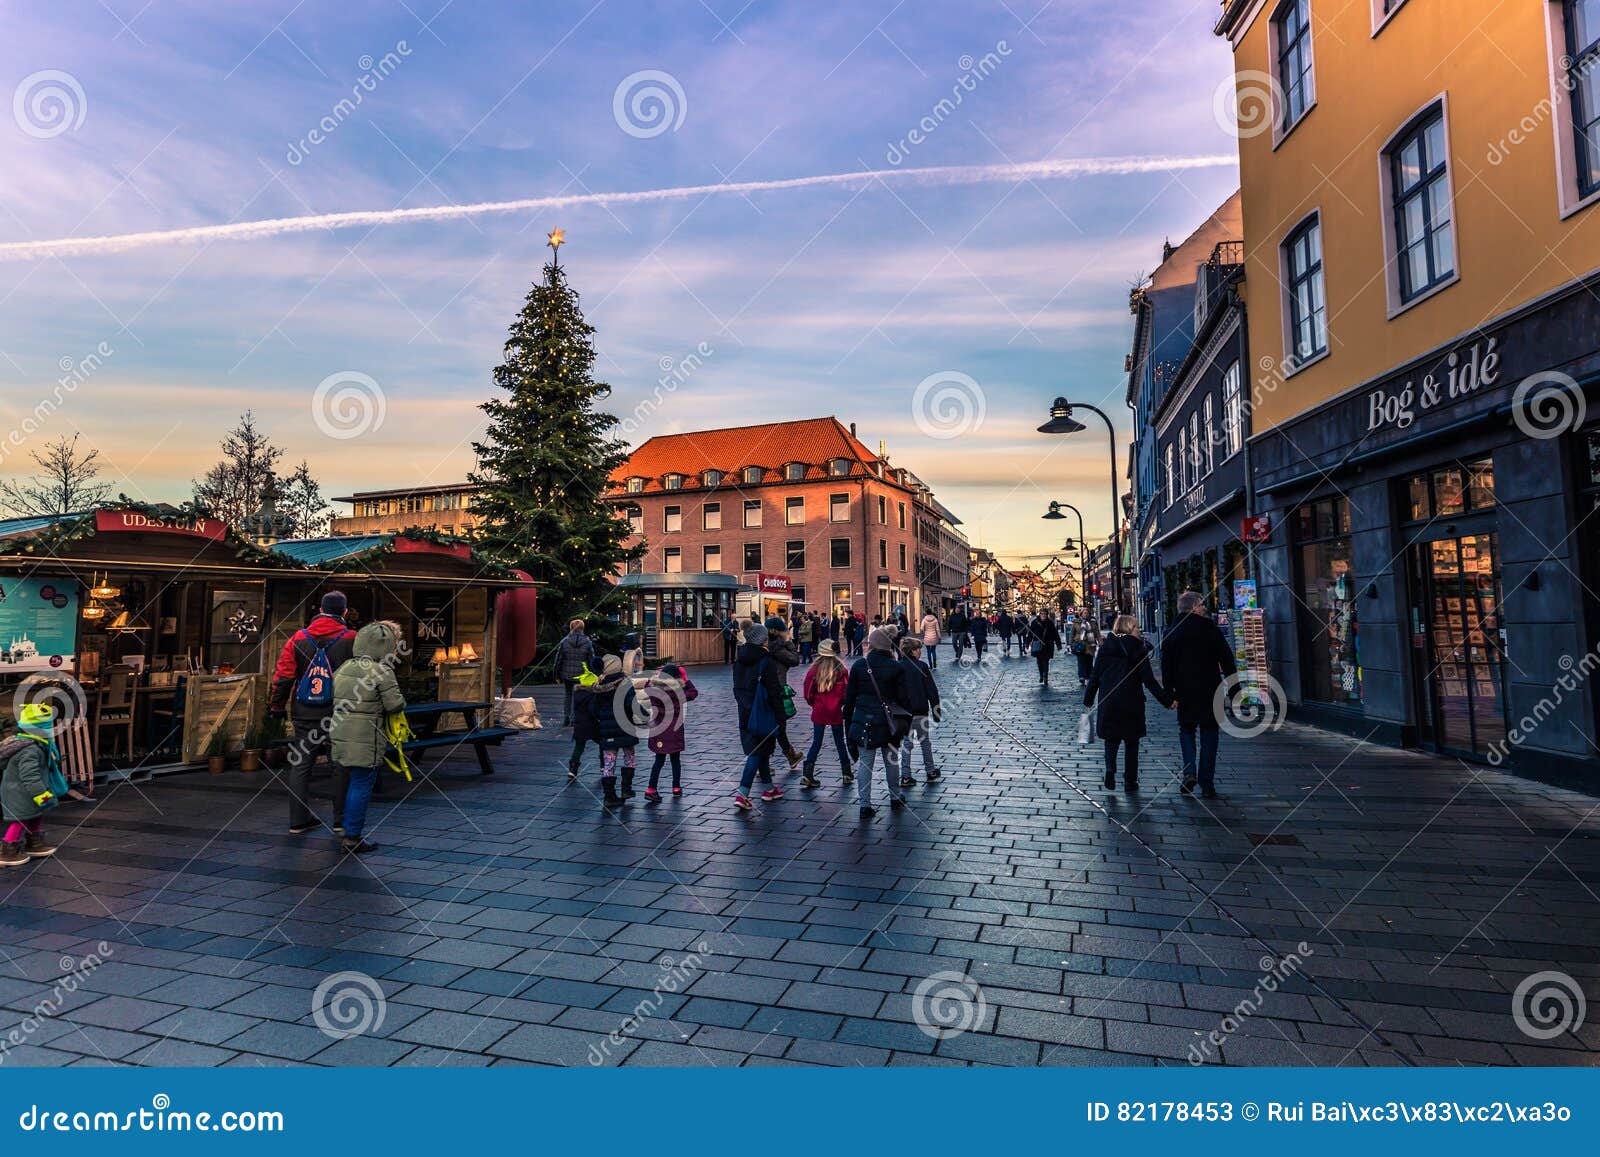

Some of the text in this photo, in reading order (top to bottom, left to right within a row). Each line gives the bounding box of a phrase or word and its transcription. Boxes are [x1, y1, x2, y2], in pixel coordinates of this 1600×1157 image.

[1368, 337, 1500, 430] Bog & idé
[763, 578, 787, 589] CHURROS
[311, 677, 323, 695] 3
